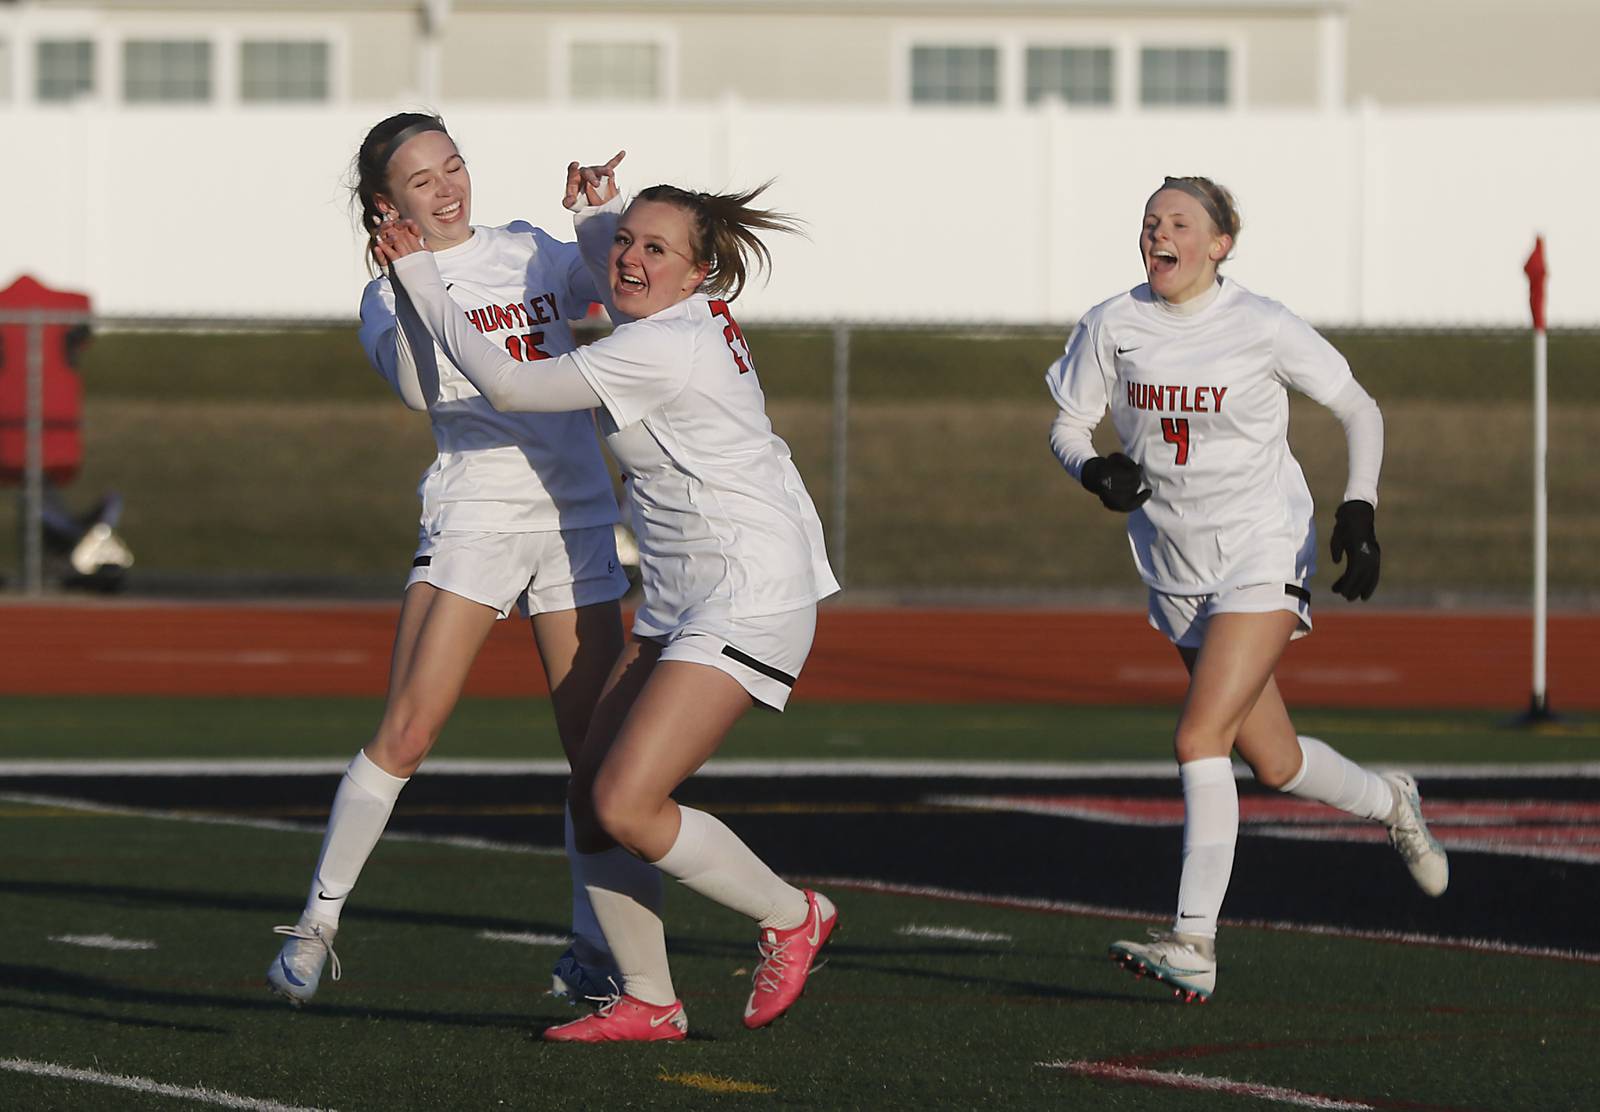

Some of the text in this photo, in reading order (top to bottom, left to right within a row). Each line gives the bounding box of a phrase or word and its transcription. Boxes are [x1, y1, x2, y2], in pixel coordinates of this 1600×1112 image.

[464, 292, 560, 334] HUNTLEY
[1127, 380, 1228, 413] HUNTLEY
[1160, 417, 1190, 465] 4
